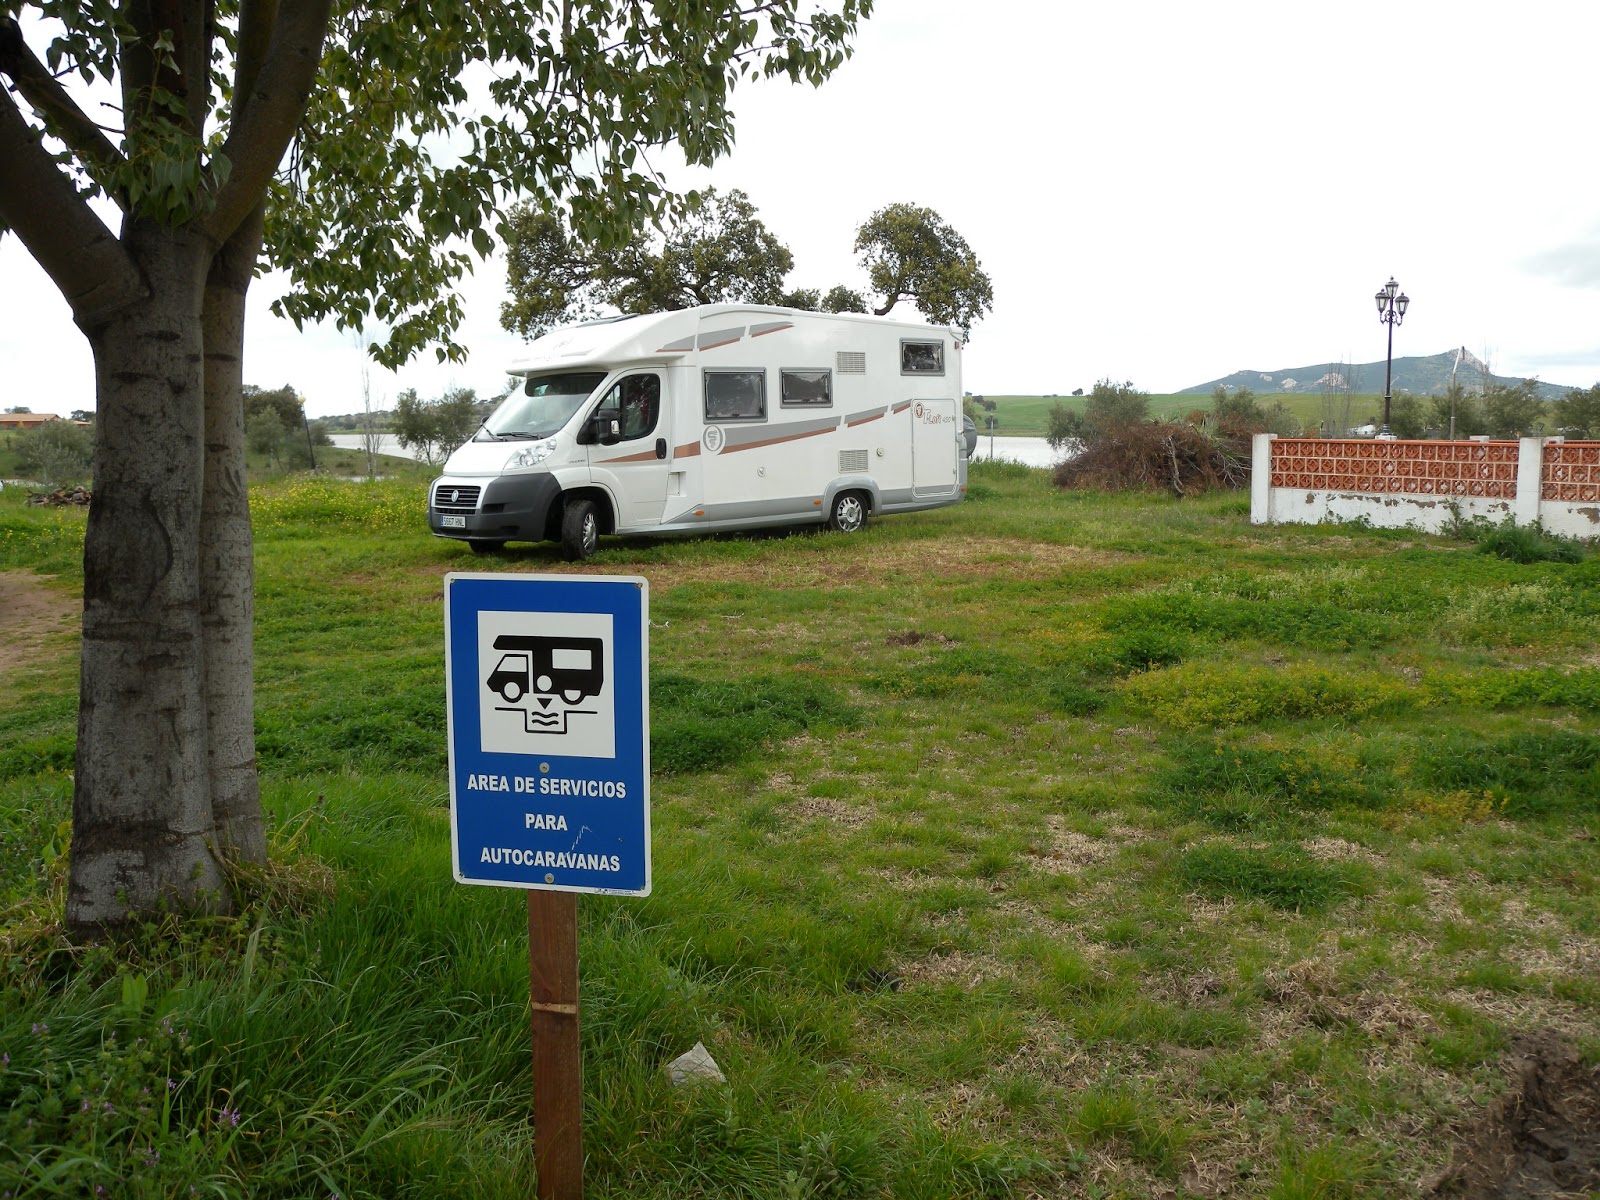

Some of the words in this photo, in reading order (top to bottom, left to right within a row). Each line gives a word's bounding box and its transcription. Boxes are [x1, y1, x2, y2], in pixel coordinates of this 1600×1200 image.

[467, 773, 510, 792] AREA
[514, 776, 535, 794] DE
[539, 777, 627, 799] SERVICIOS
[525, 813, 568, 831] PARA
[480, 847, 621, 872] AUTOCARAVANAS
